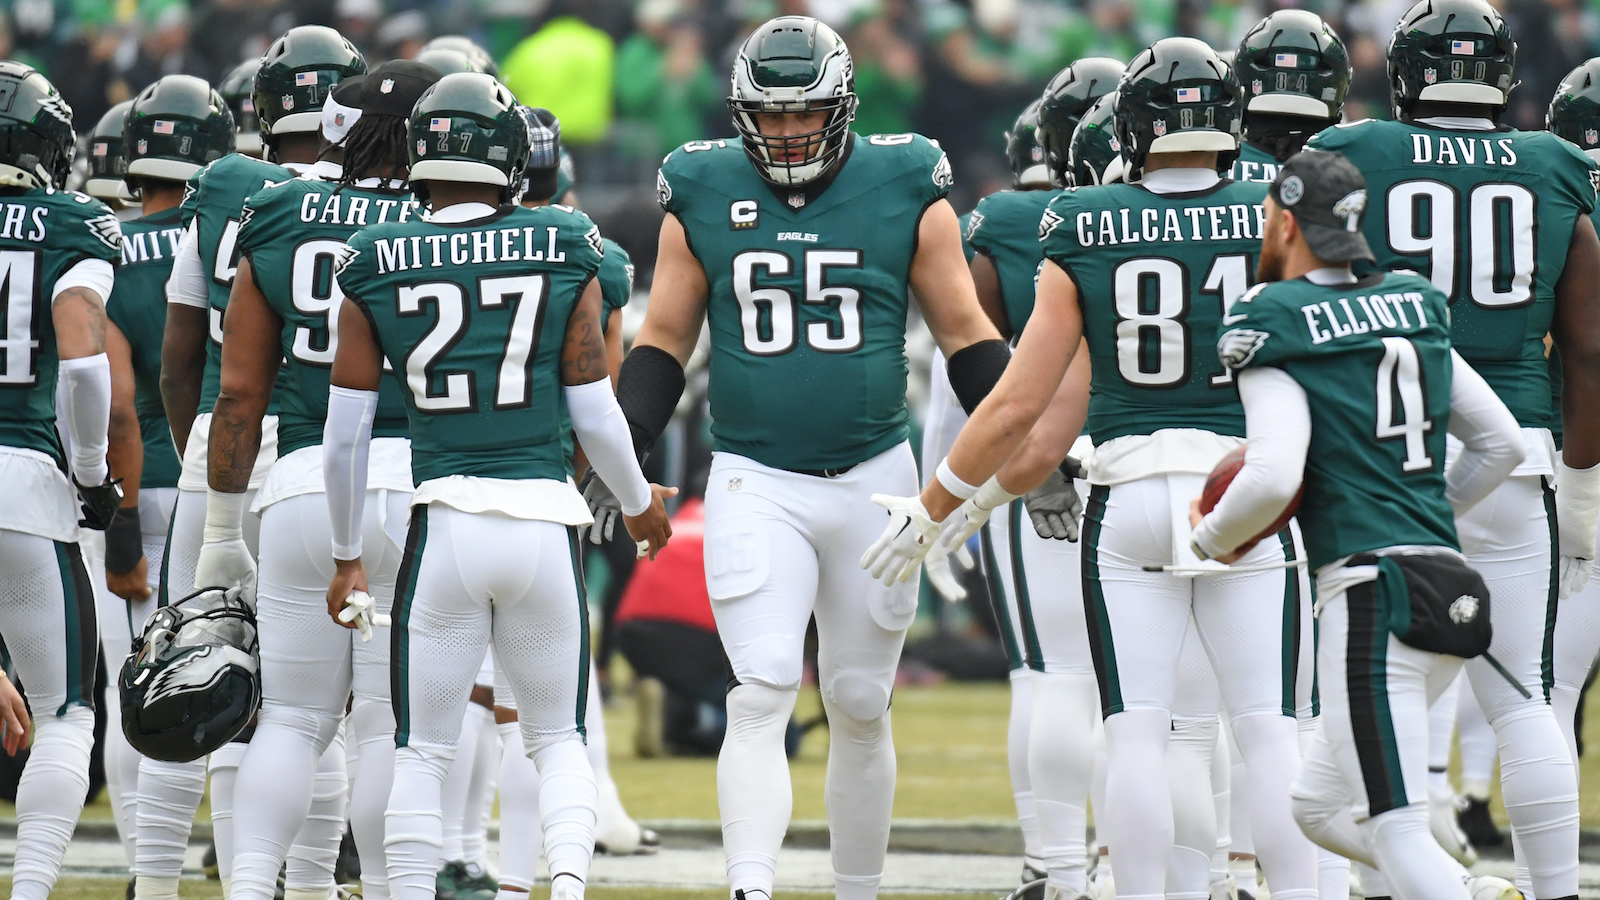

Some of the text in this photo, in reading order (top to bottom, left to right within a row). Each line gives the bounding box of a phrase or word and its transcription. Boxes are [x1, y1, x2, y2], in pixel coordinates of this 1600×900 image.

[1276, 72, 1307, 92] 84
[1451, 60, 1486, 81] 90
[1180, 106, 1214, 128] 81
[437, 131, 472, 153] 27
[1410, 133, 1517, 166] DAVIS
[0, 203, 48, 242] RS
[731, 200, 757, 222] C
[375, 227, 566, 274] MITCHELL
[777, 232, 818, 242] EAGLES
[1388, 180, 1534, 306] 90
[733, 251, 861, 353] 65
[1115, 255, 1248, 385] 81
[1301, 292, 1428, 345] ELLIOTT
[398, 274, 545, 410] 27
[1376, 336, 1433, 472] 4
